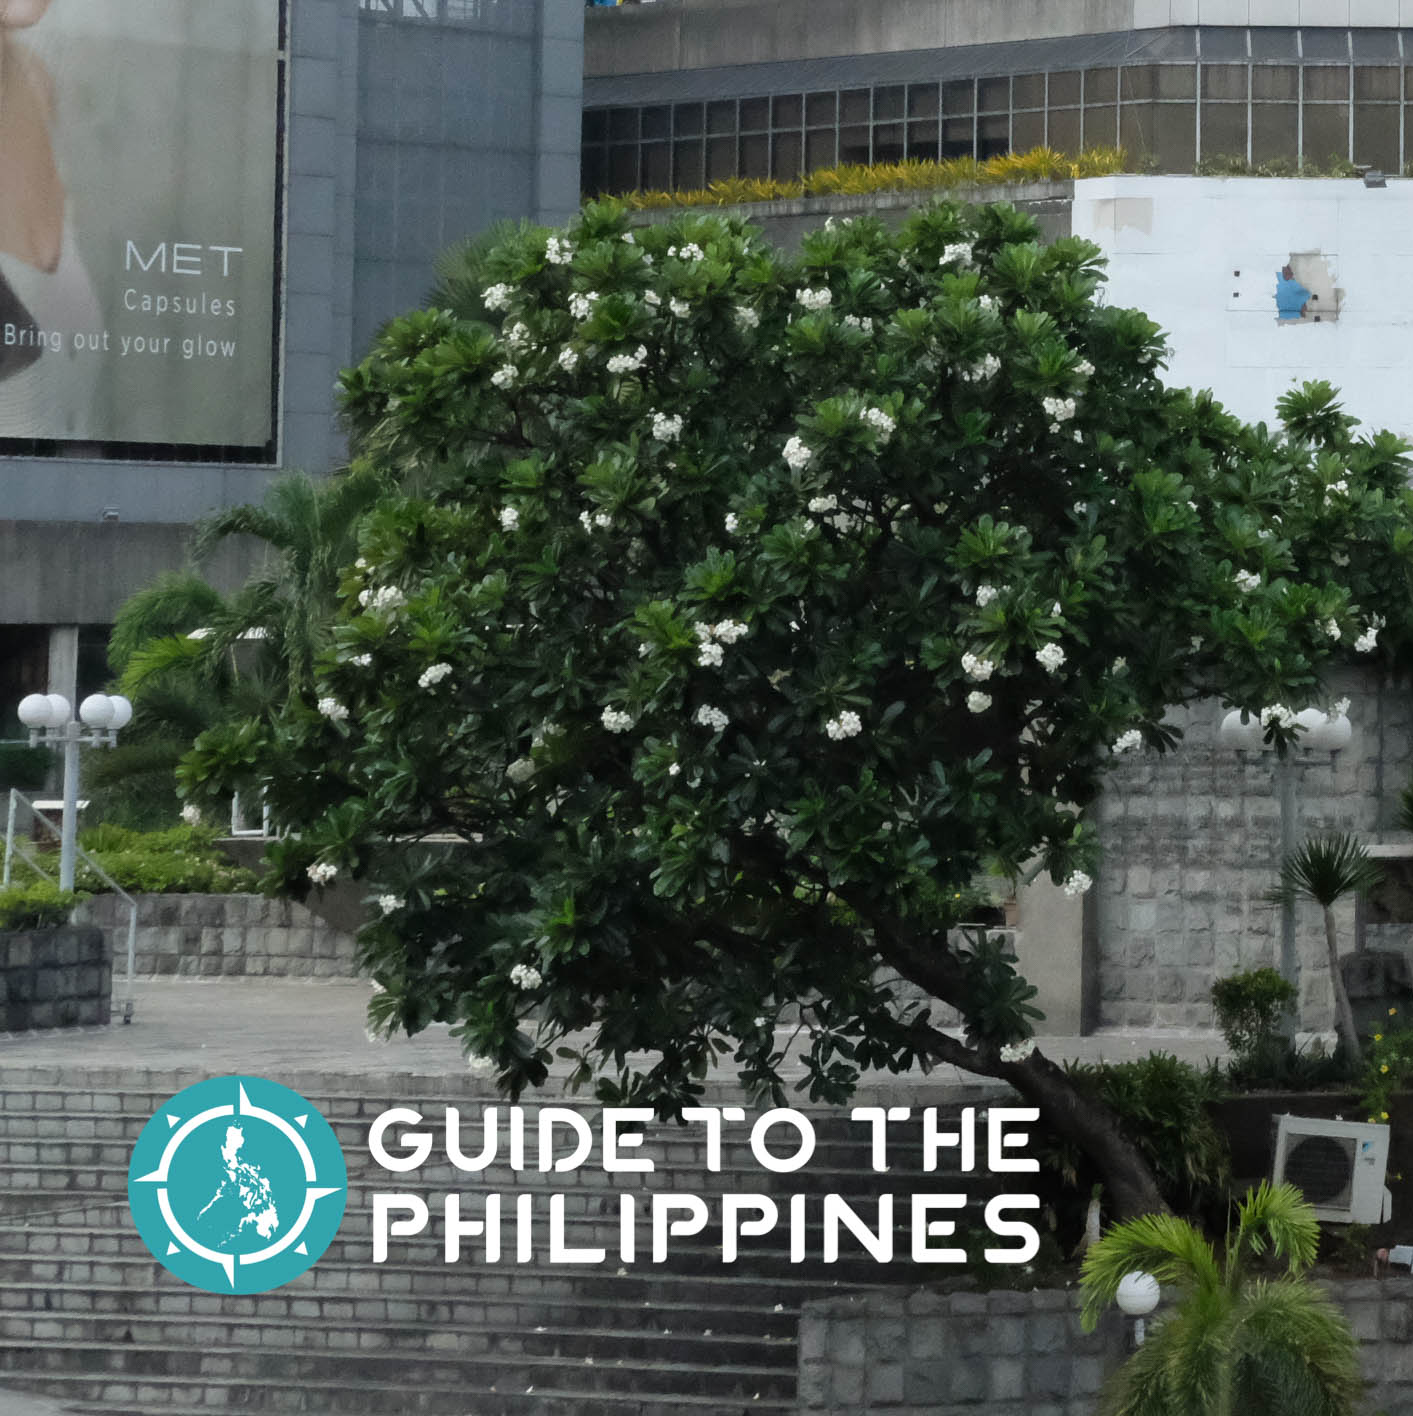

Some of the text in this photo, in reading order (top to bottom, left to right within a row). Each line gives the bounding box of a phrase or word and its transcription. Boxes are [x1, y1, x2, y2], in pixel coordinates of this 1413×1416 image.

[124, 240, 244, 277] MET
[124, 288, 236, 317] Capsules
[4, 323, 236, 360] Bring out your glow
